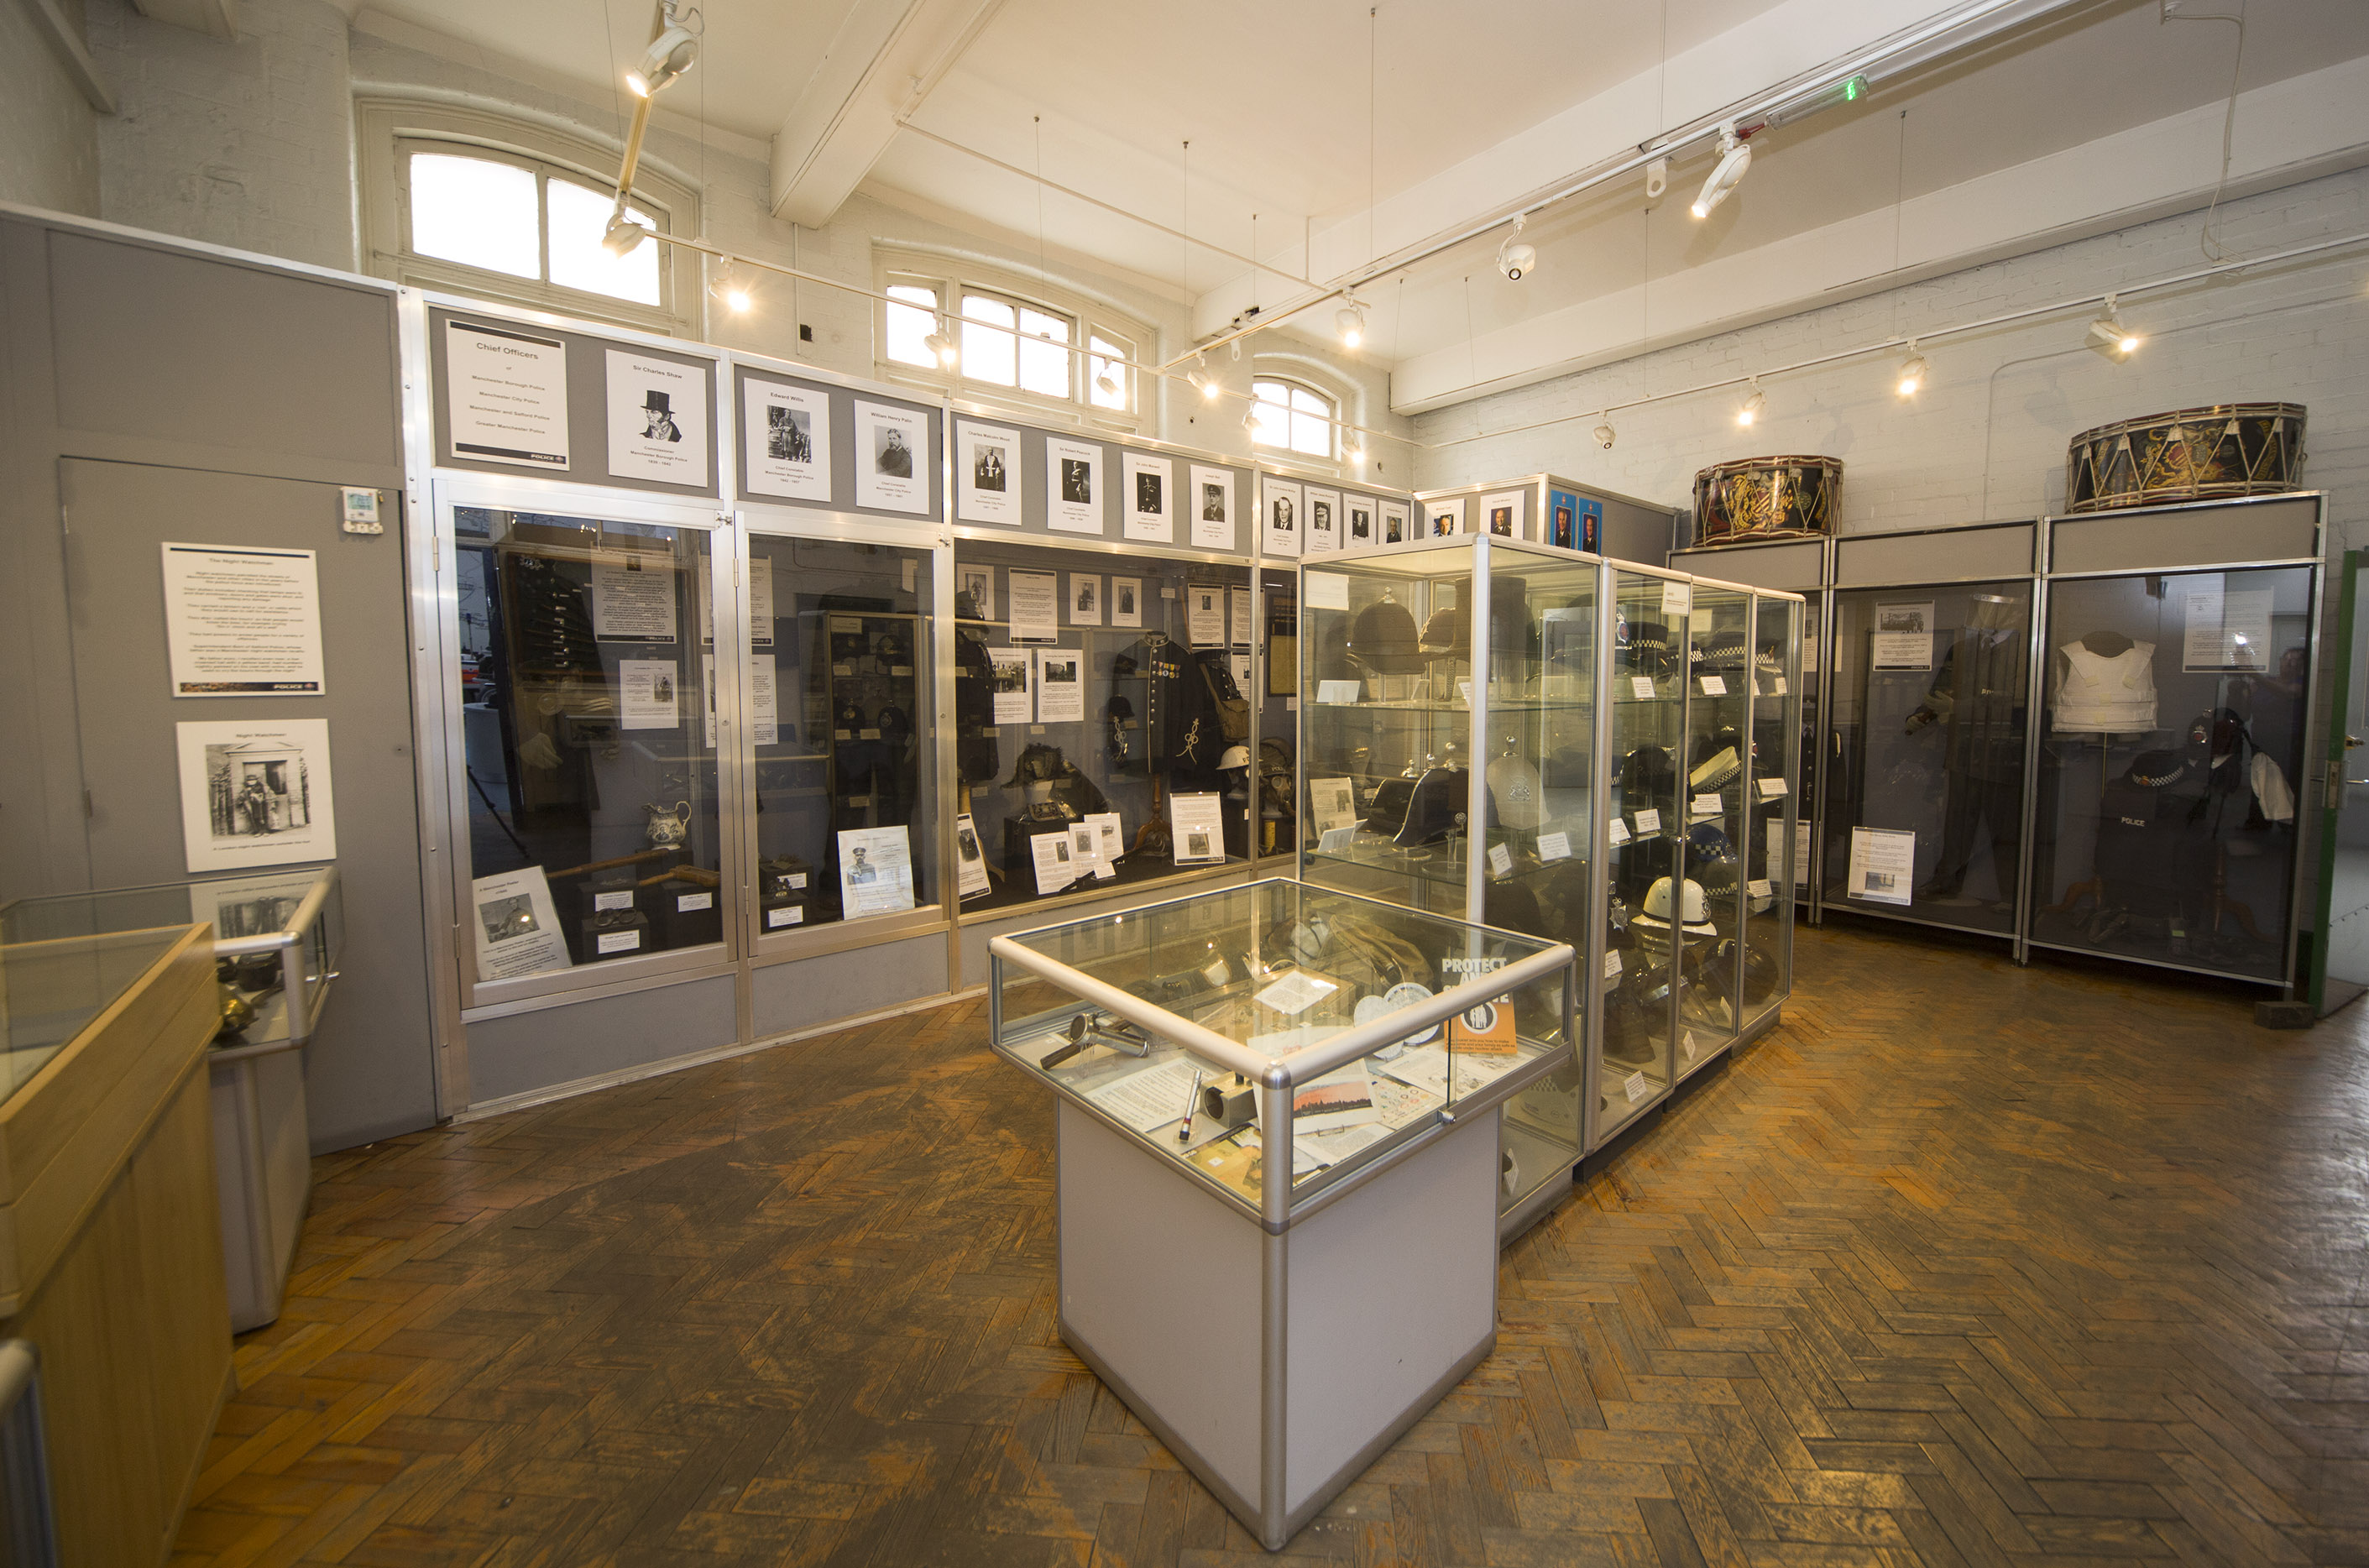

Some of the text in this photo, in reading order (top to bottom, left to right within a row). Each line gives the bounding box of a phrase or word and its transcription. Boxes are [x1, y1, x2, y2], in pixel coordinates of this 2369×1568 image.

[477, 342, 539, 359] Chief Officers
[643, 367, 665, 376] Charles
[667, 371, 682, 379] Shaw
[771, 392, 789, 400] Edward
[2122, 816, 2146, 827] POLICE
[1442, 958, 1507, 972] PROTECT
